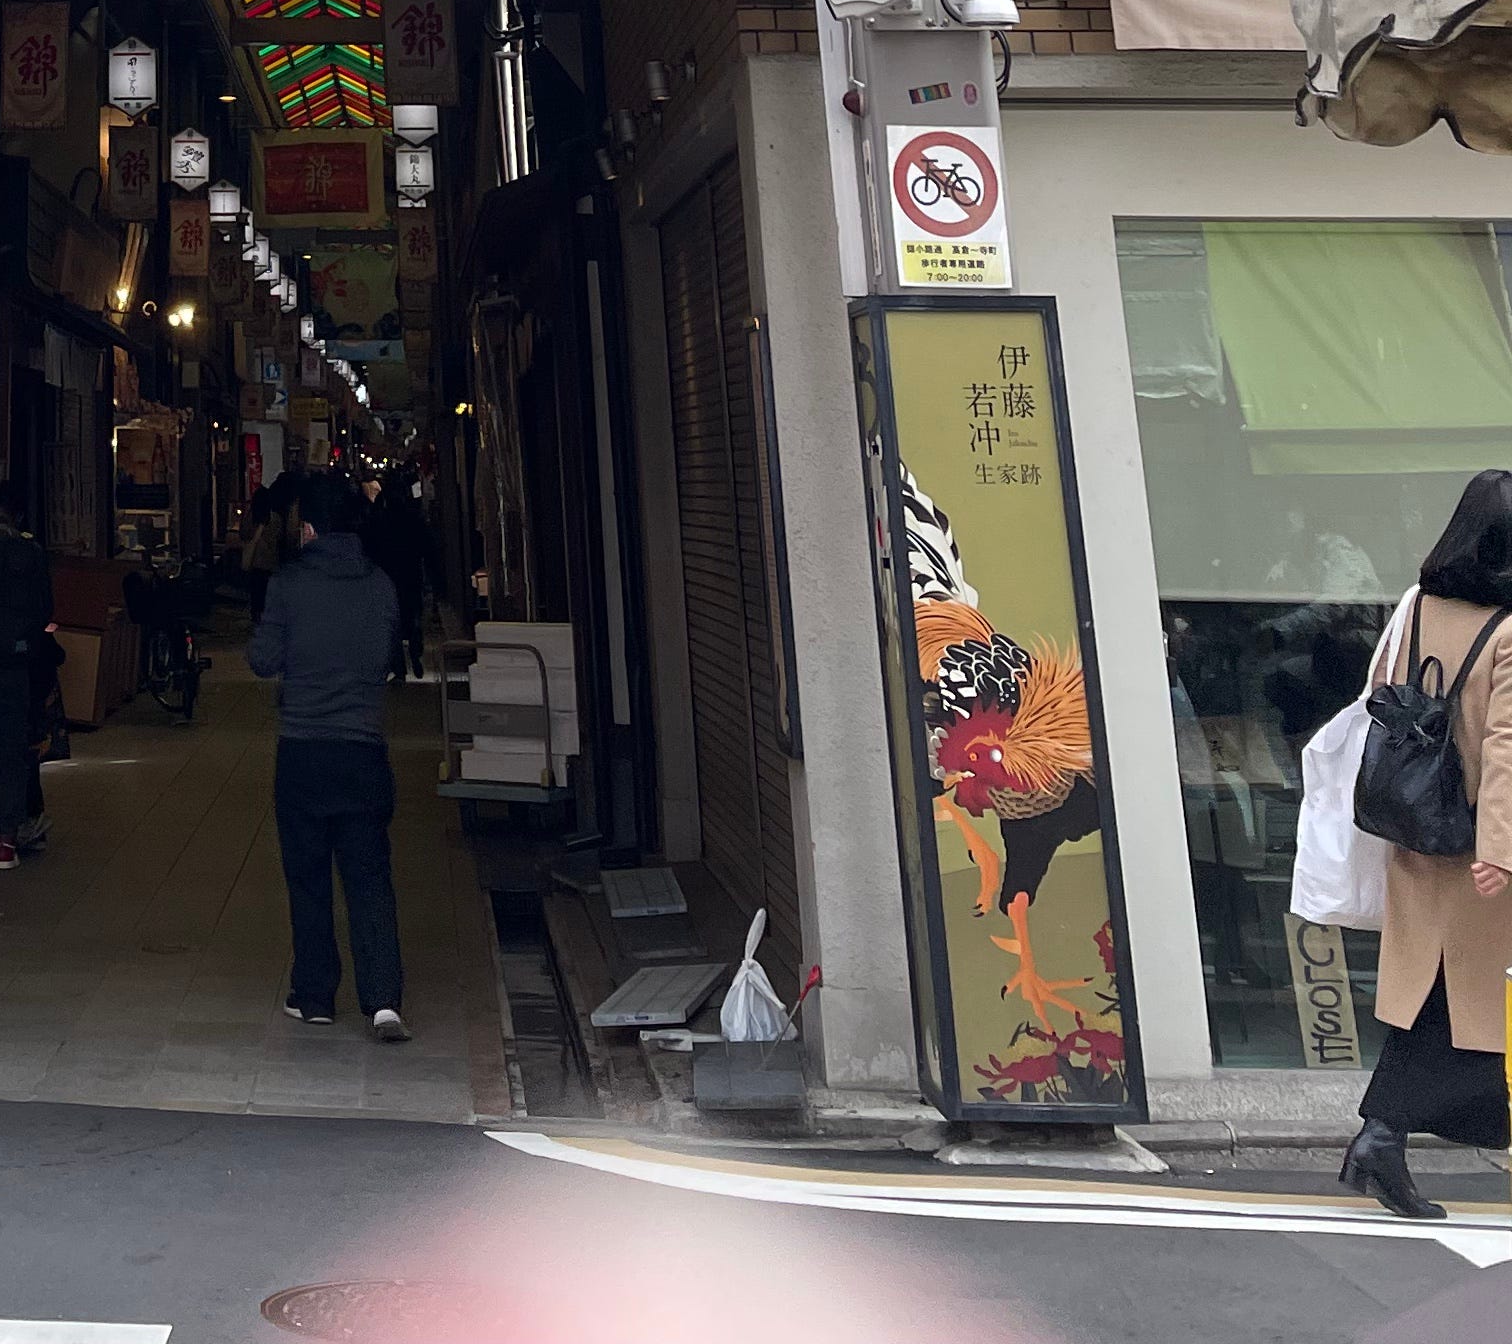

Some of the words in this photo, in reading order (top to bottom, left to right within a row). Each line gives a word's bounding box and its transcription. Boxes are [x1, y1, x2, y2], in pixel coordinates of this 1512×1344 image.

[997, 344, 1037, 419] 伊藤
[962, 383, 1001, 456] 若冲
[974, 463, 1042, 486] 生家跡
